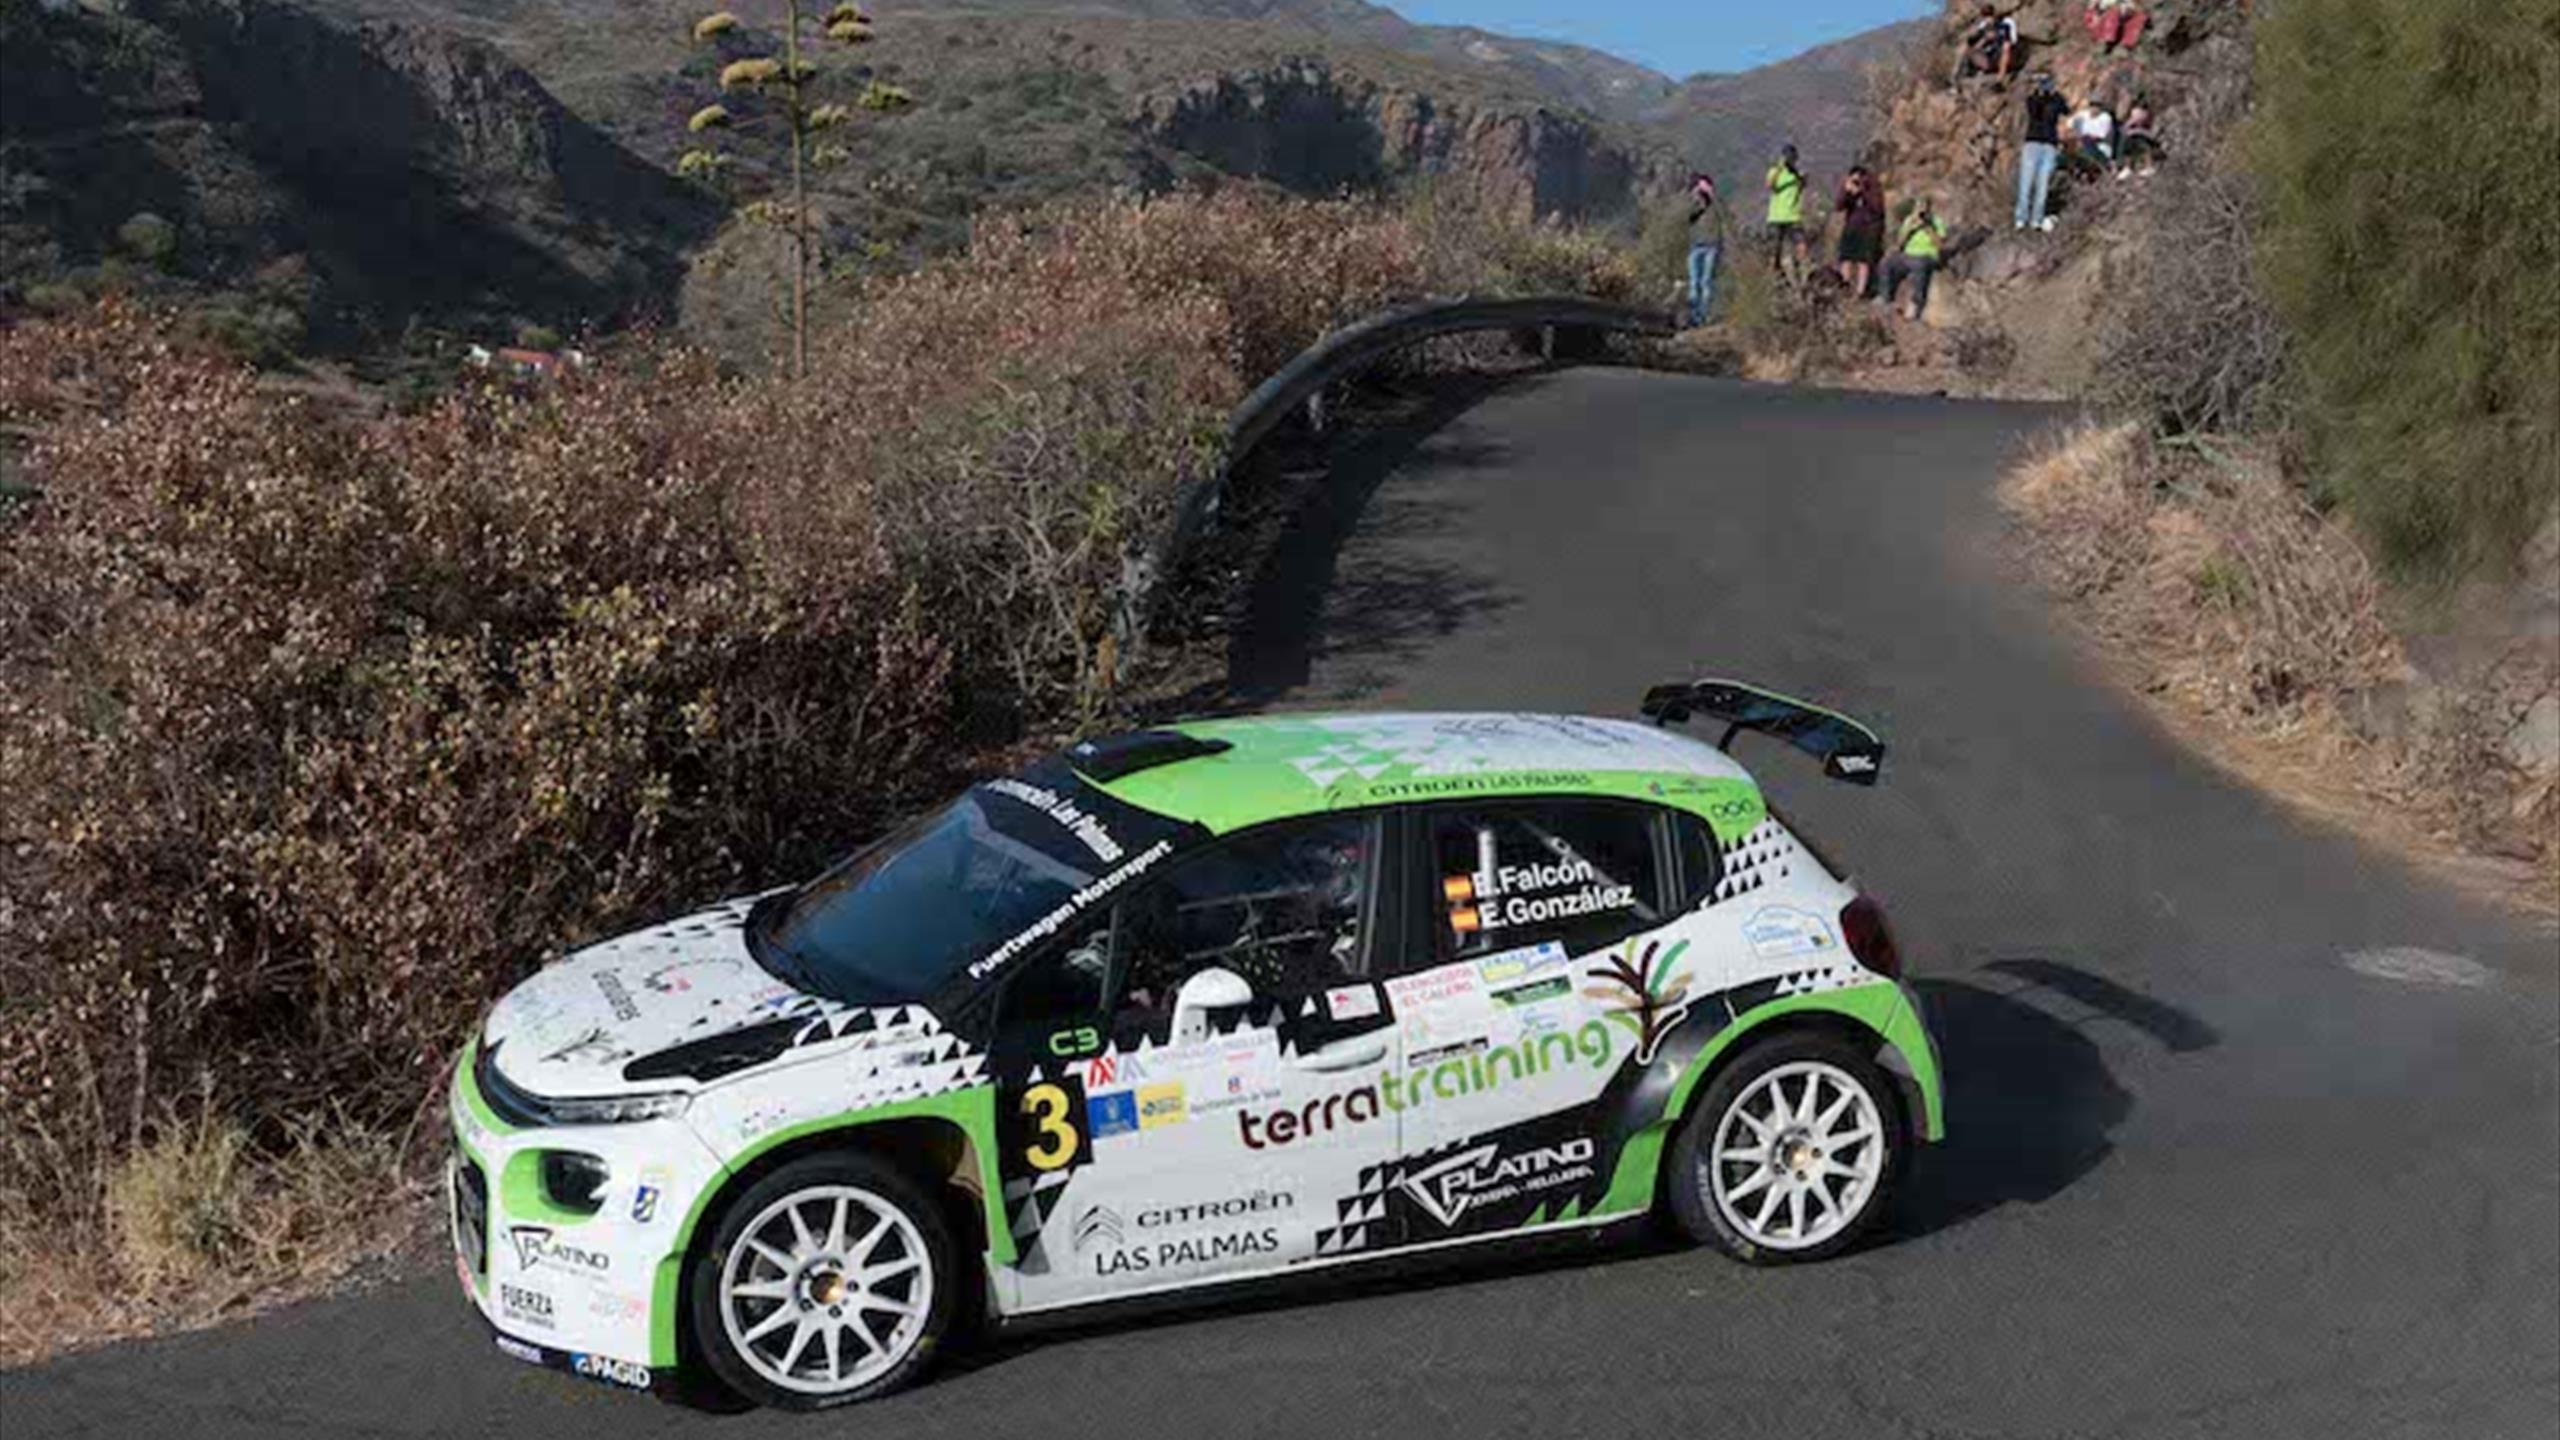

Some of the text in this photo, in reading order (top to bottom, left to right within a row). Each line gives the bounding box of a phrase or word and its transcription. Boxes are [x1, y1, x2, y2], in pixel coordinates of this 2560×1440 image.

[1489, 775, 1521, 789] LAS
[1523, 773, 1592, 787] PALMAS
[968, 839, 1174, 979] Fuertwagen Motorsport
[1478, 885, 1636, 929] E.González
[1050, 1027, 1100, 1055] C3
[1021, 1083, 1079, 1170] 3
[1439, 1138, 1595, 1206] PLATINO
[524, 1236, 610, 1270] PLATINO
[1096, 1227, 1279, 1276] LAS PALMAS
[589, 1354, 651, 1388] PAGID
